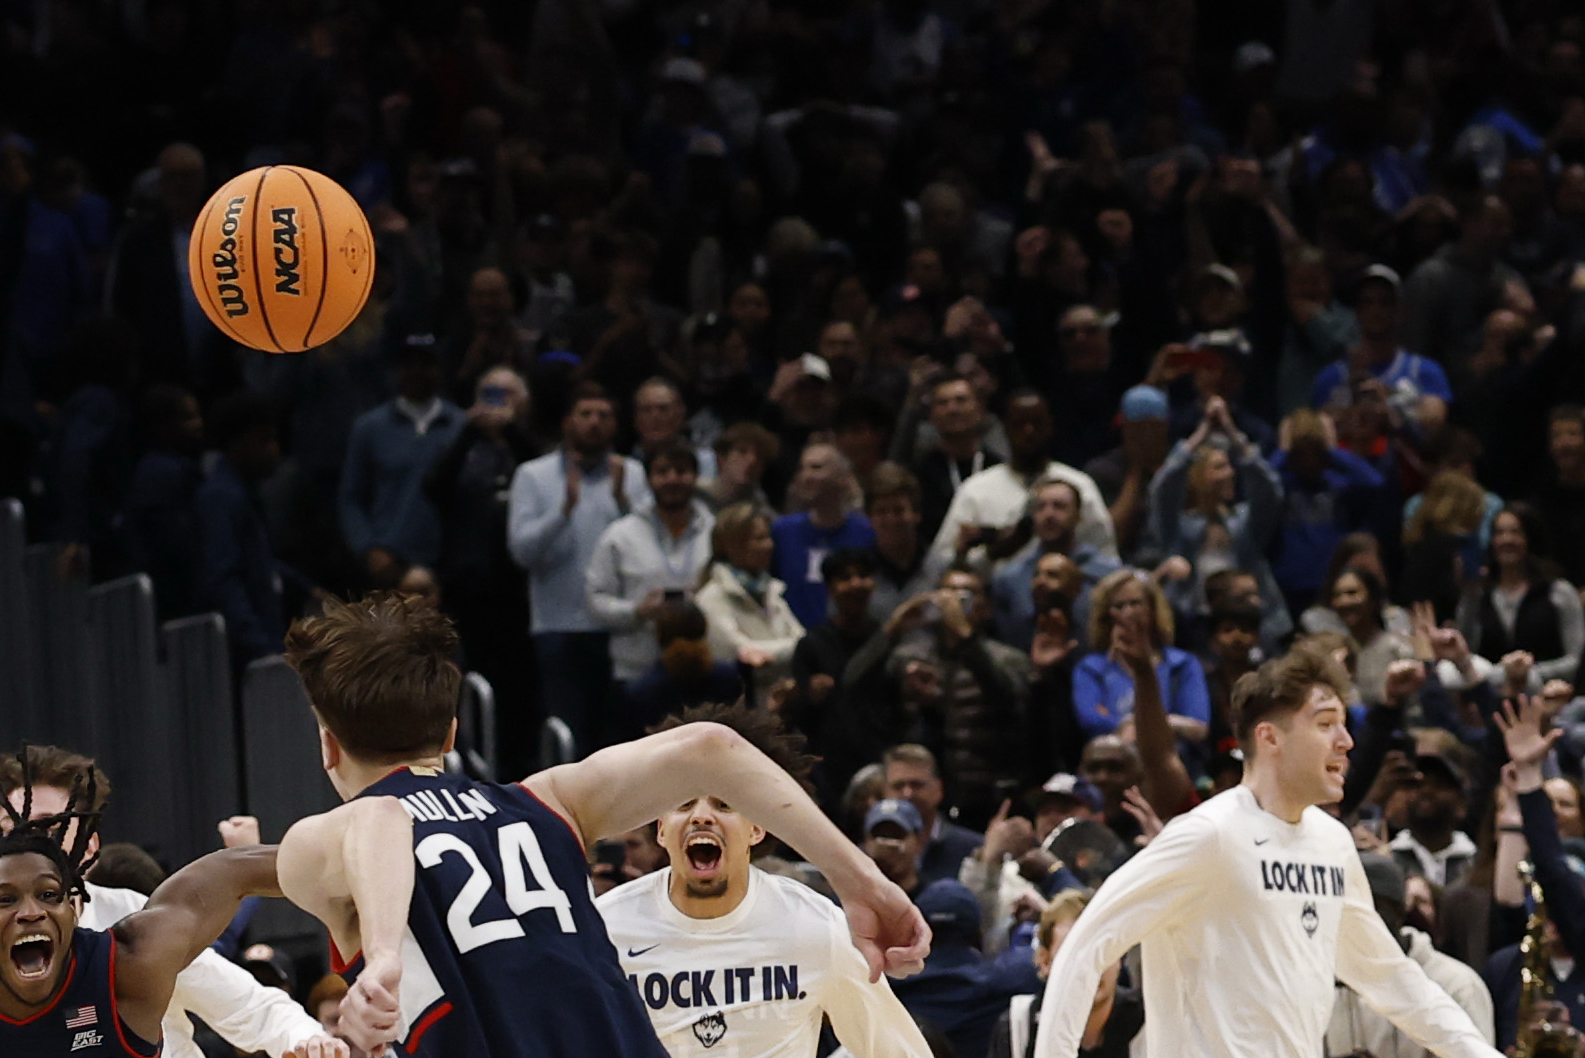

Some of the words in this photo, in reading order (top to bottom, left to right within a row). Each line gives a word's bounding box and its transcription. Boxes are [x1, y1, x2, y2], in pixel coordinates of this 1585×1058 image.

[213, 195, 250, 319] Wilson
[271, 206, 301, 296] NCAA
[415, 821, 577, 955] 24
[1260, 860, 1310, 894] LOCK
[1311, 864, 1327, 896] IT
[724, 967, 755, 1005] IT
[762, 965, 807, 1001] IN.
